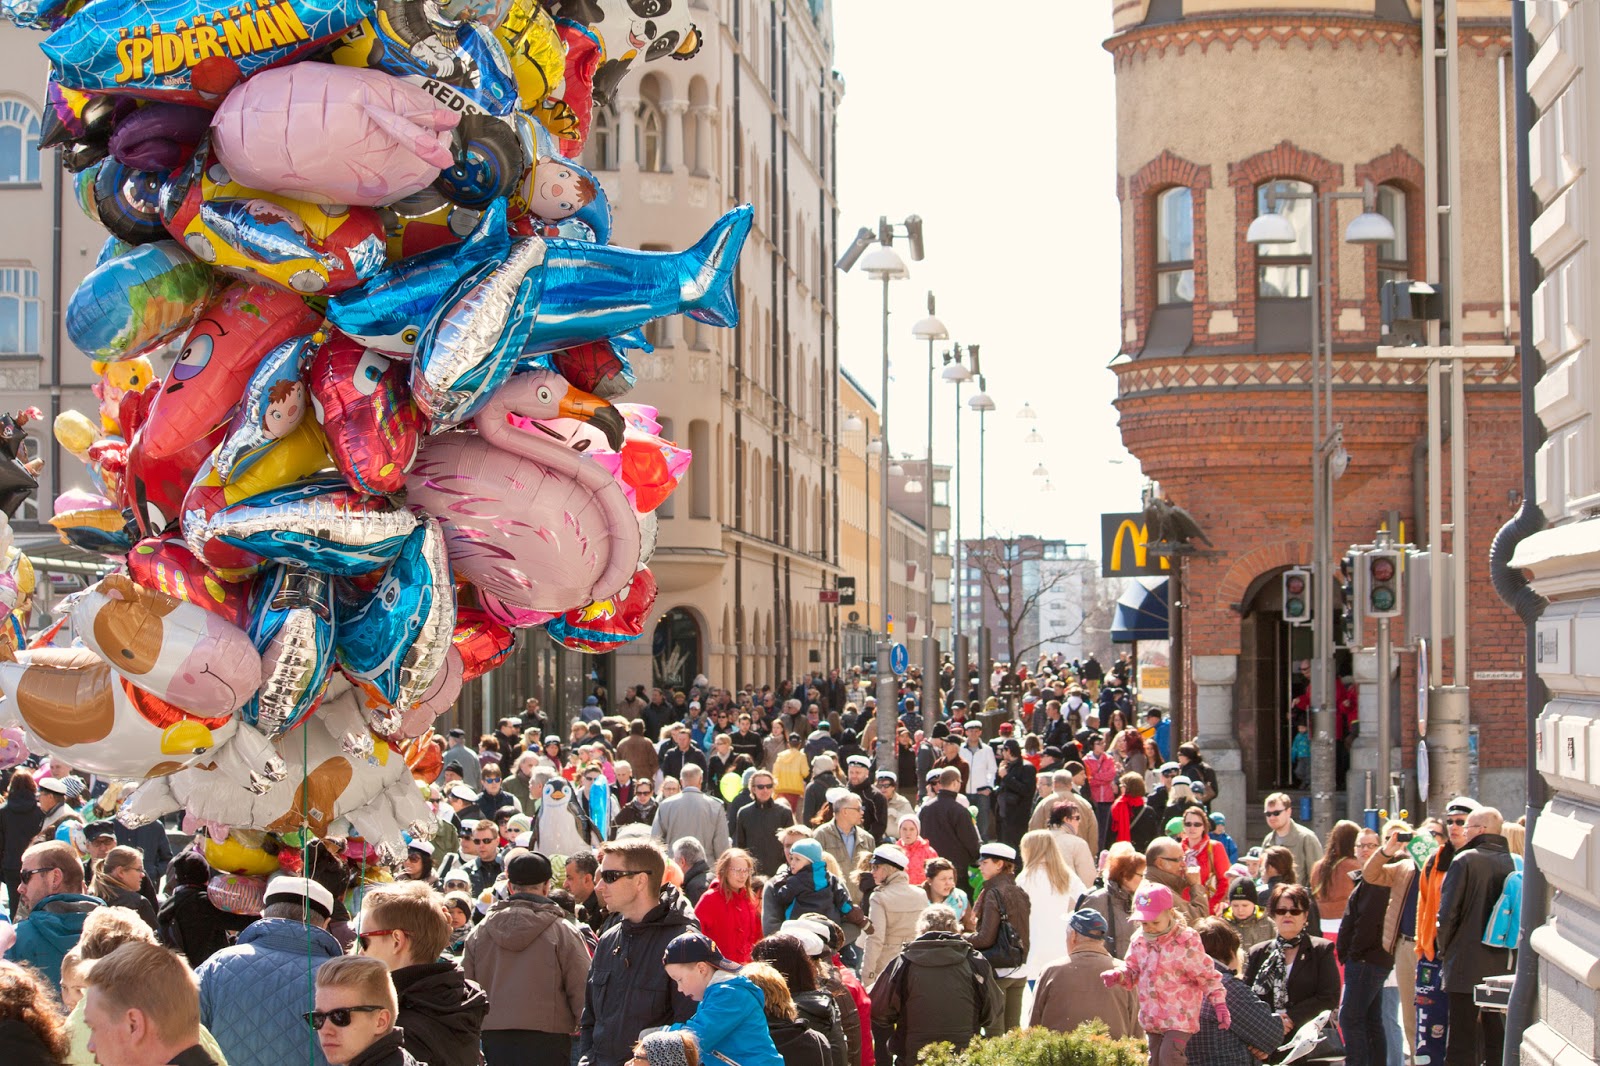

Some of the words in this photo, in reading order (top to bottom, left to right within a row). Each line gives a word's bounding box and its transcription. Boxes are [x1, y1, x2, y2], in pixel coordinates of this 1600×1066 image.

[114, 1, 311, 84] SPIDER-MAN
[119, 23, 161, 38] THE
[176, 0, 275, 29] AMAZIN
